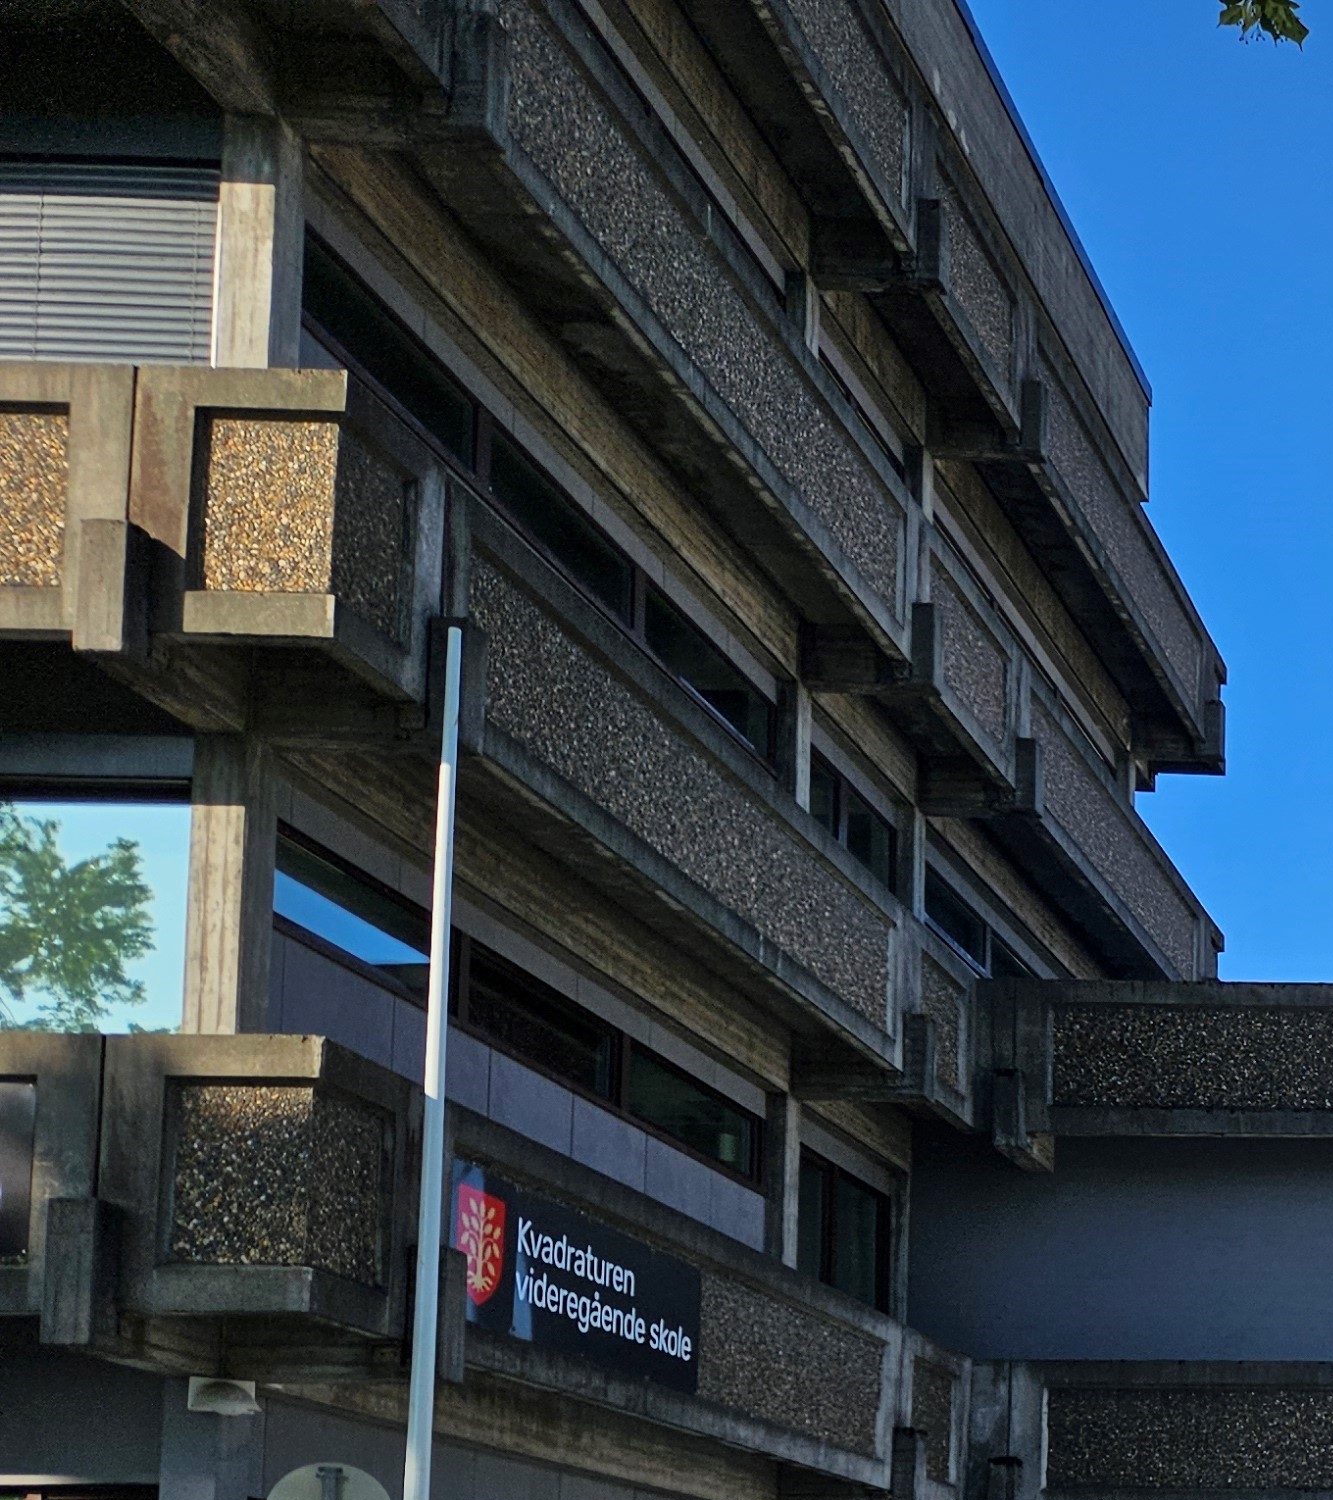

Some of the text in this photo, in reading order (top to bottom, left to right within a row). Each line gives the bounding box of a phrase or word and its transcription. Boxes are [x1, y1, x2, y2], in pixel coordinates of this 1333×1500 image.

[517, 1216, 635, 1297] Kvadraturen
[515, 1267, 692, 1361] videregående skole
